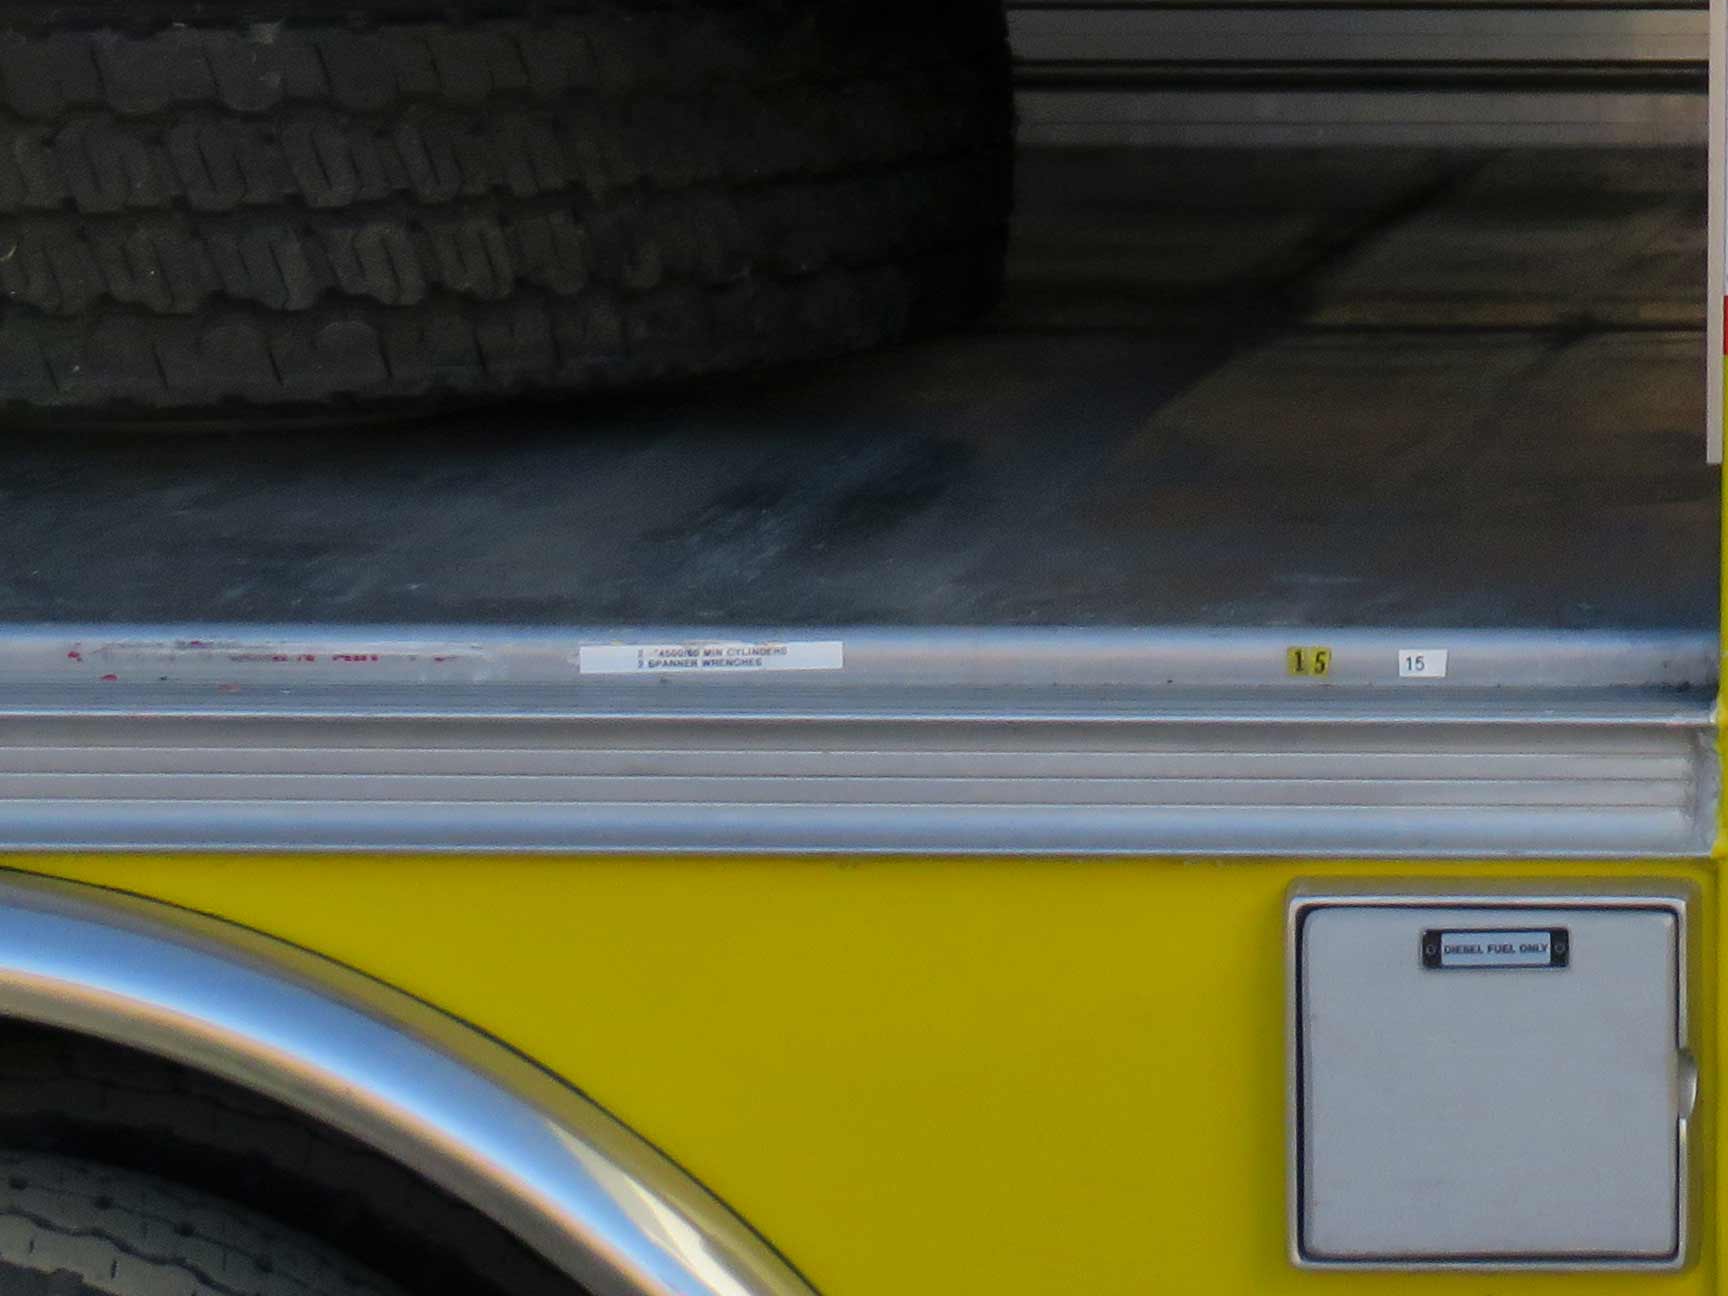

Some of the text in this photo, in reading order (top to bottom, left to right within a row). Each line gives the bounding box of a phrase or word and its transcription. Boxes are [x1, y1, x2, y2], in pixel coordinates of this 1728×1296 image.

[704, 648, 723, 657] MIN
[726, 646, 788, 656] CYLINDERS
[647, 658, 698, 668] SPANNER
[702, 658, 763, 668] WRENCHES
[1406, 655, 1425, 672] 15
[1443, 943, 1549, 954] DIESEL FUEL ONLY
